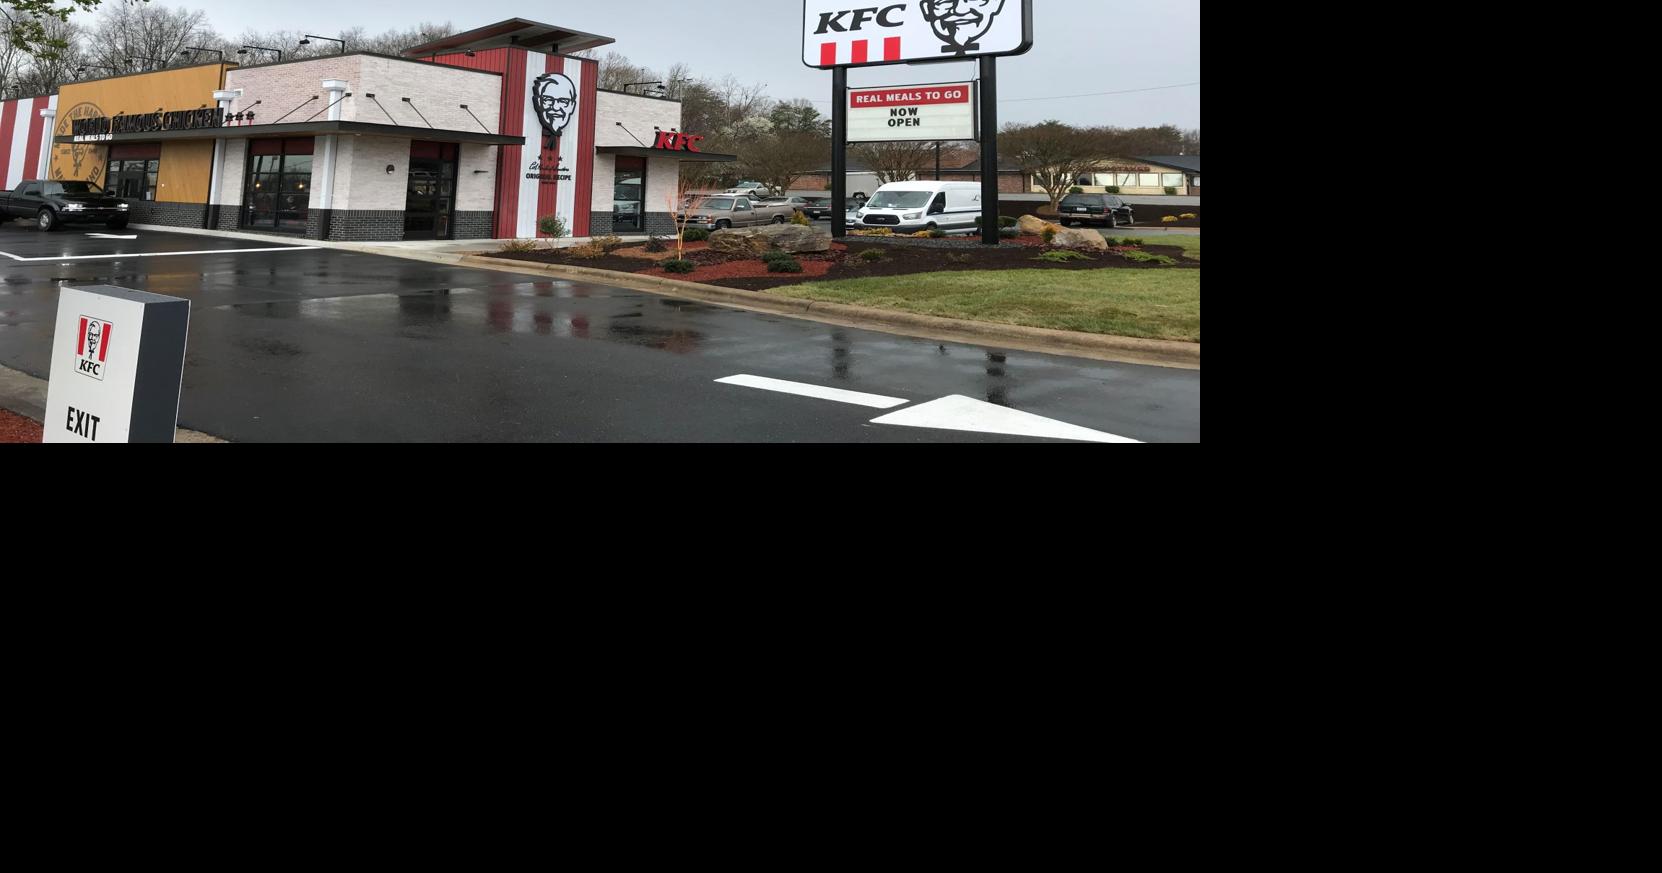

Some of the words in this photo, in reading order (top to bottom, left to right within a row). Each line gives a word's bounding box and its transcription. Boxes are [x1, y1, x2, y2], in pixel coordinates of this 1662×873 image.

[813, 3, 907, 35] KFC
[856, 95, 883, 103] REAL
[886, 92, 922, 102] MEALS
[925, 91, 940, 100] TO
[944, 90, 961, 99] GO
[890, 107, 918, 117] NOW
[111, 111, 163, 133] FAMOUS
[162, 108, 224, 130] CHICKEN
[887, 117, 921, 127] OPEN
[84, 134, 99, 142] MEALS
[99, 133, 105, 141] TO
[105, 133, 113, 141] GO
[655, 130, 704, 153] KFC
[79, 359, 100, 375] KFC
[66, 406, 100, 441] EXIT
